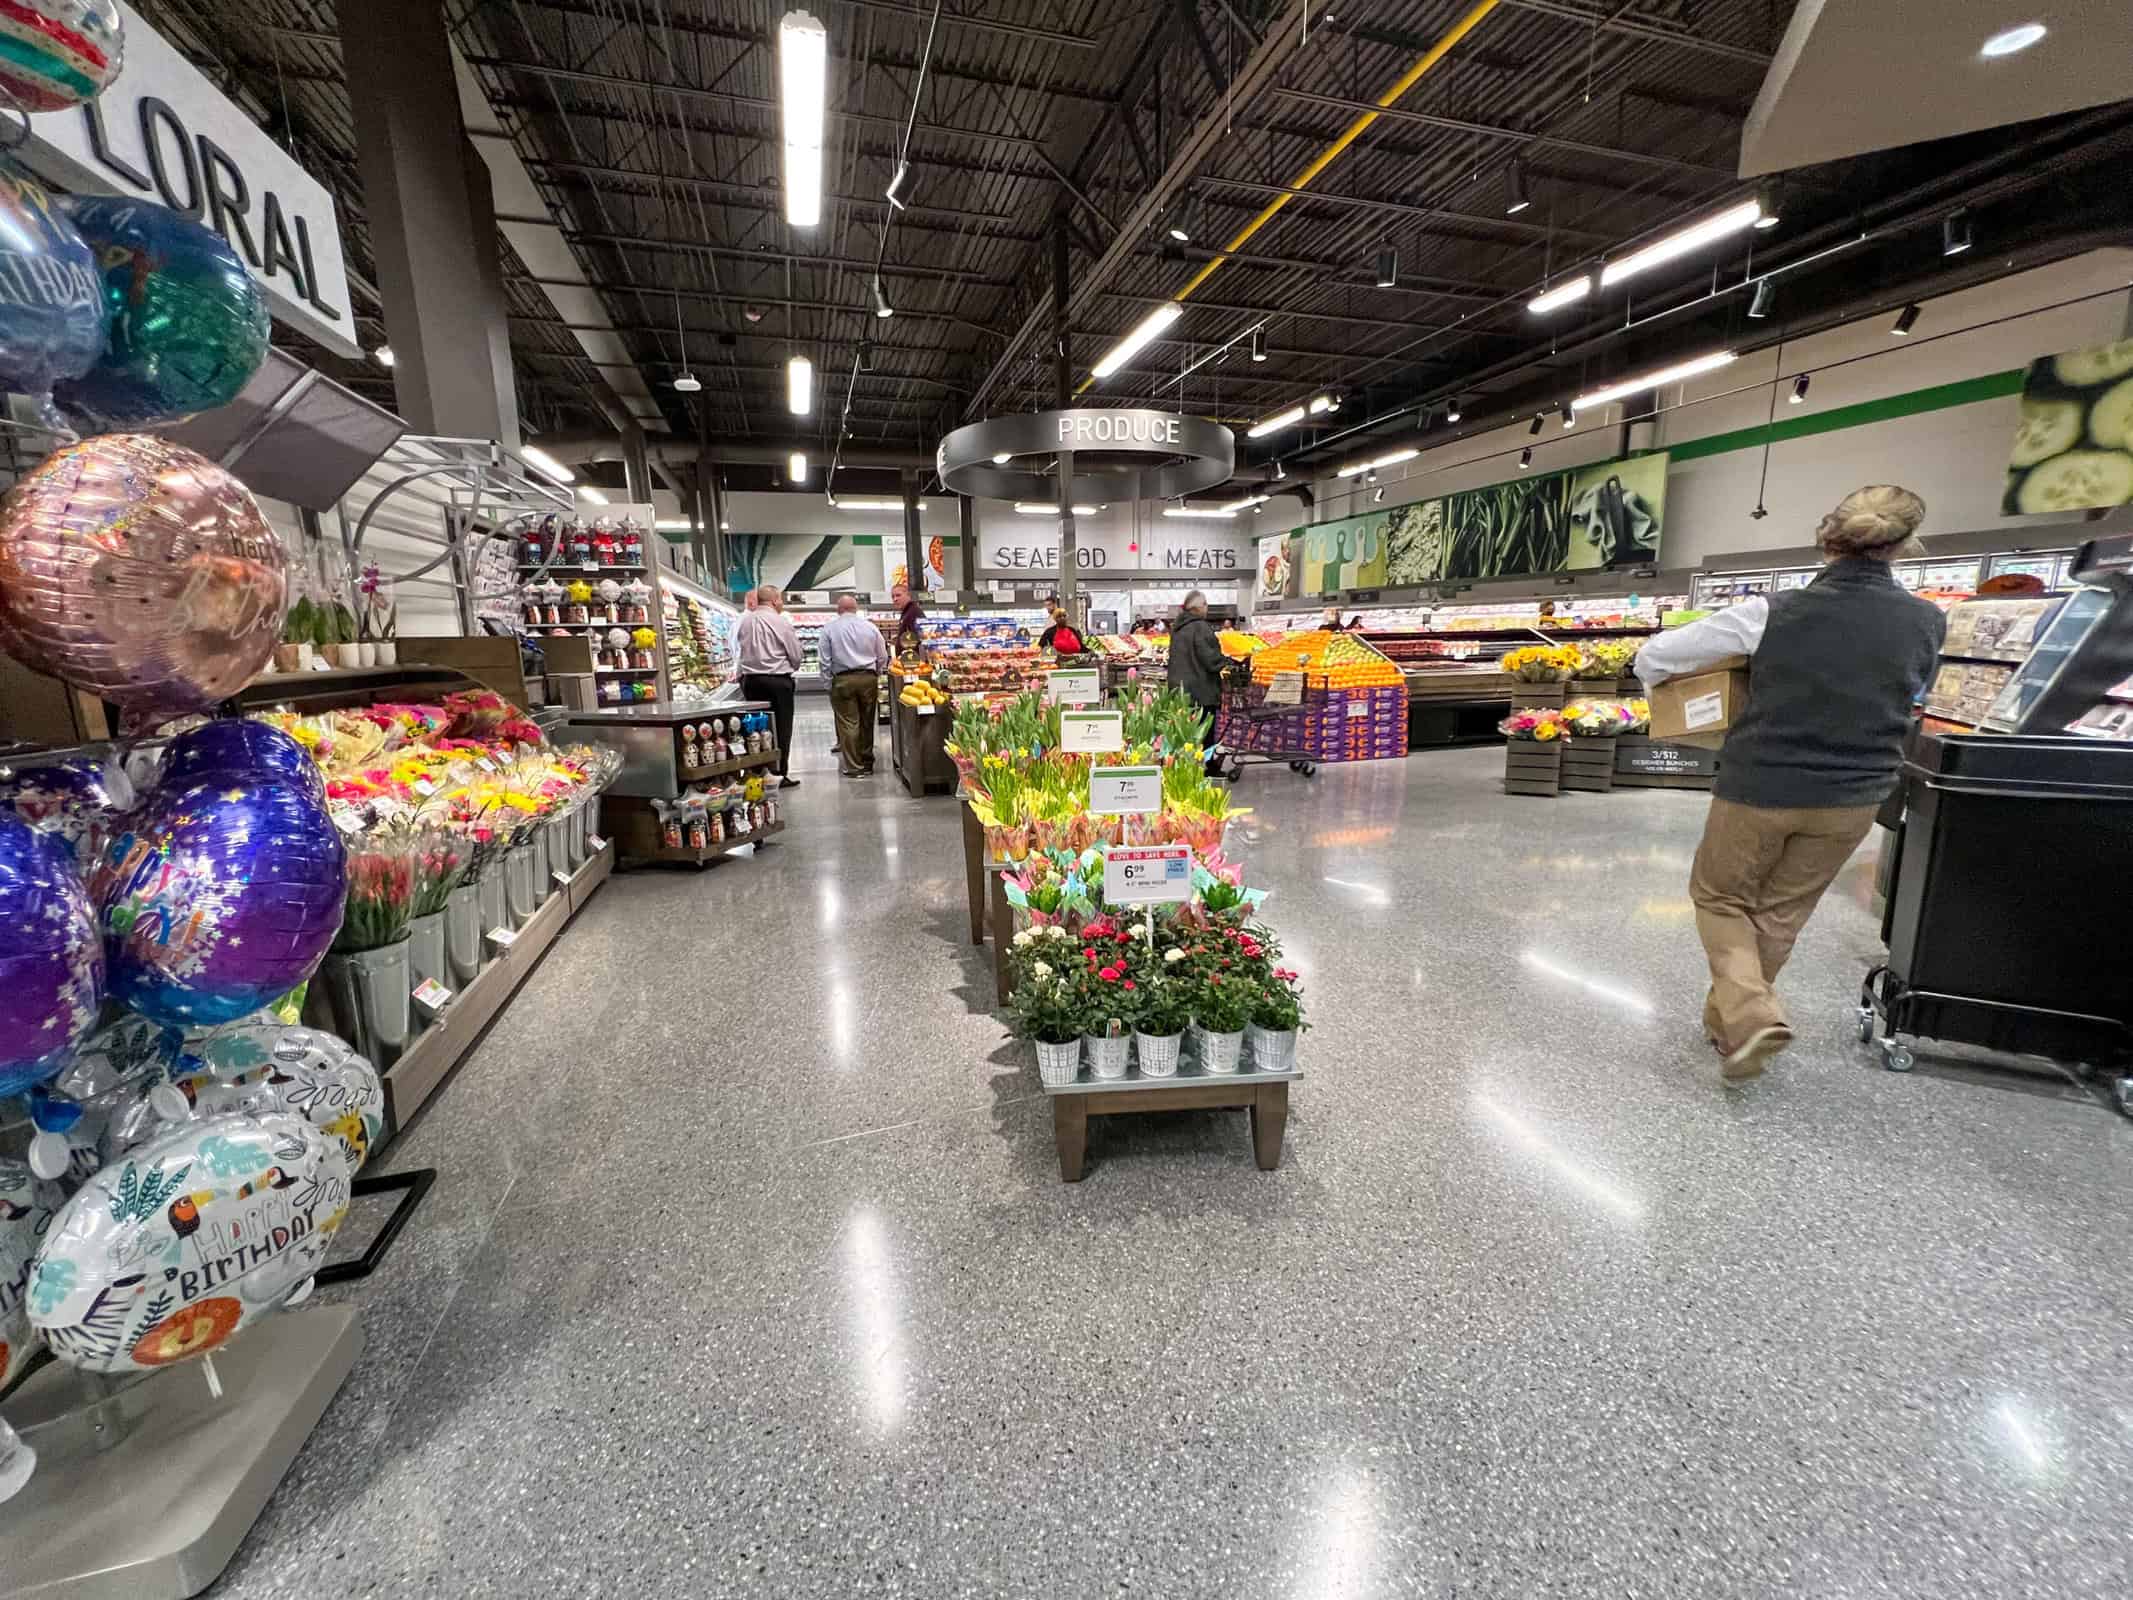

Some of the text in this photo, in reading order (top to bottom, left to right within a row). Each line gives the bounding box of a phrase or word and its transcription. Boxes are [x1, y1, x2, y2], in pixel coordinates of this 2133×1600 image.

[84, 97, 340, 321] LORAL
[1058, 416, 1180, 444] PRODUCE
[996, 547, 1106, 568] SEAFOD
[1166, 550, 1236, 568] MEATS
